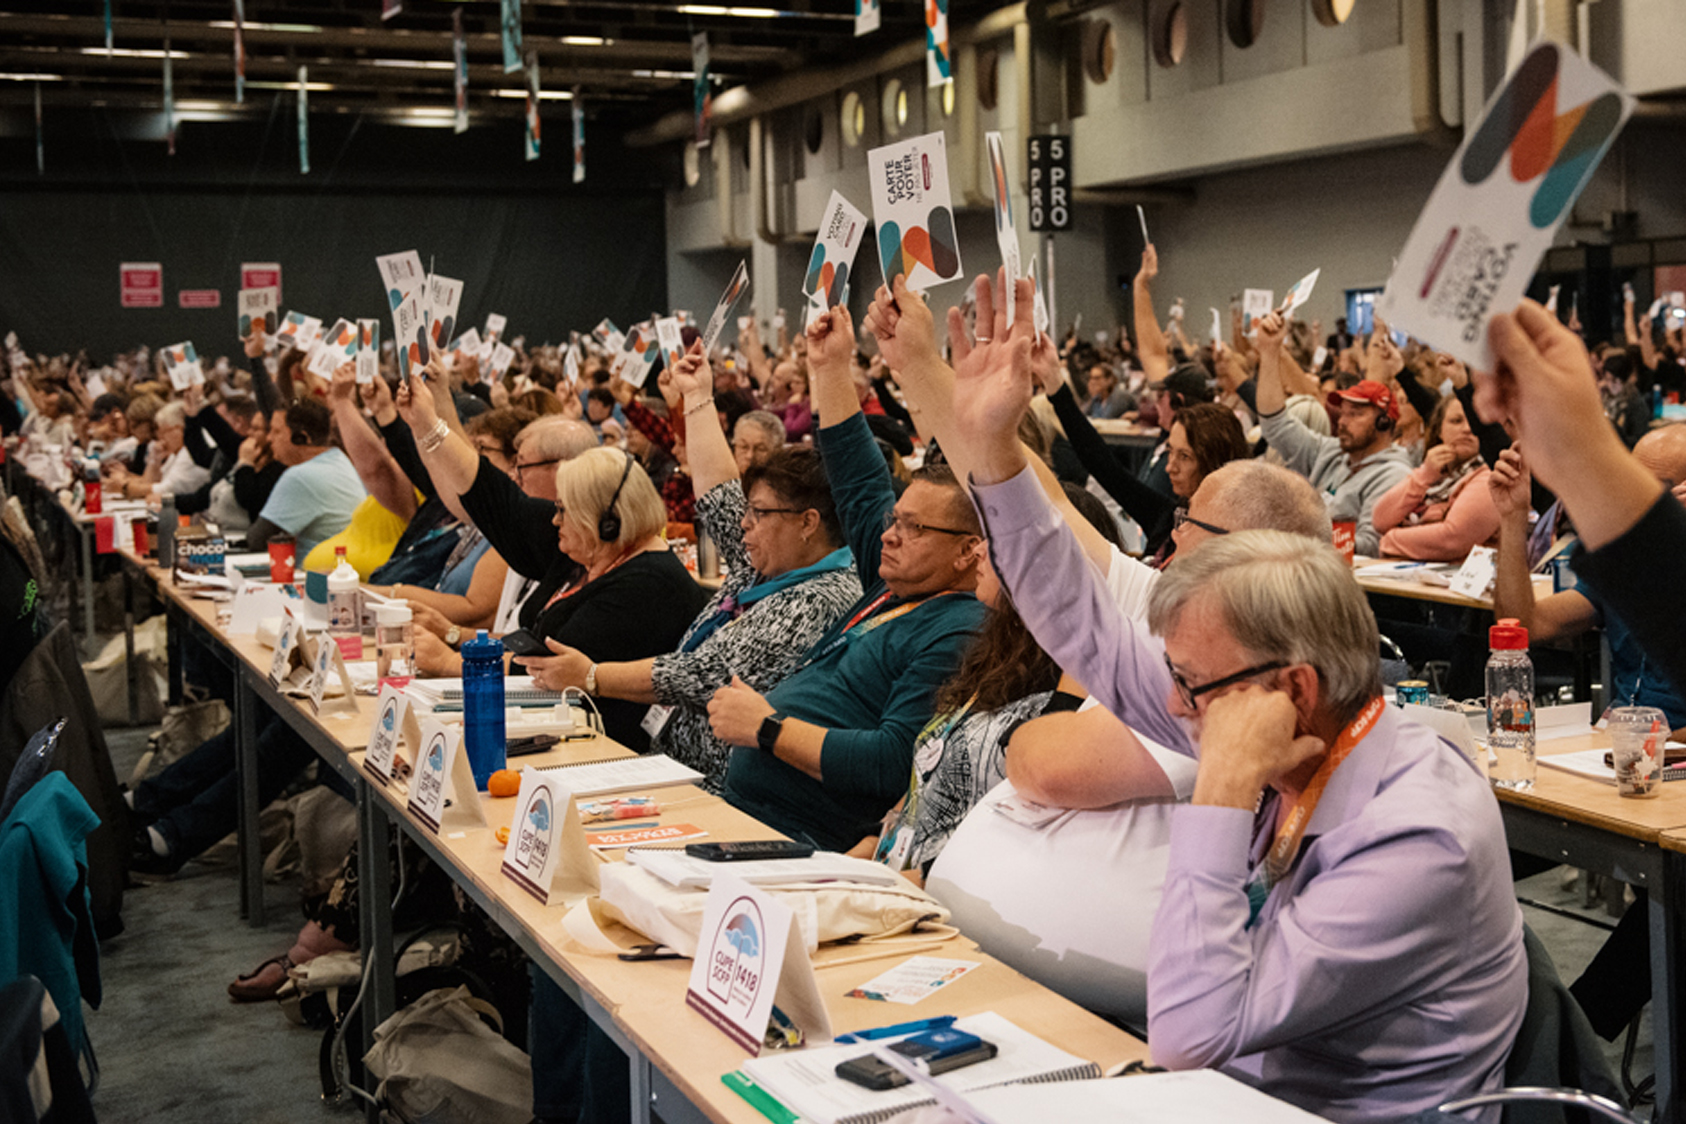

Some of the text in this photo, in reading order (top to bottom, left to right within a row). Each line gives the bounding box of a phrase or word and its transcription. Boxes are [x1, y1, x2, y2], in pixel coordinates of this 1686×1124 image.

[1030, 139, 1041, 161] 5
[1050, 139, 1065, 161] 5
[884, 159, 898, 205] CARTE
[894, 160, 906, 199] POUR
[903, 153, 915, 201] VOTER
[1031, 167, 1044, 228] PRO
[1050, 166, 1069, 227] PRO
[177, 543, 225, 556] choco
[715, 950, 735, 972] CUPE
[712, 965, 732, 985] SCFP
[735, 965, 758, 992] 1418
